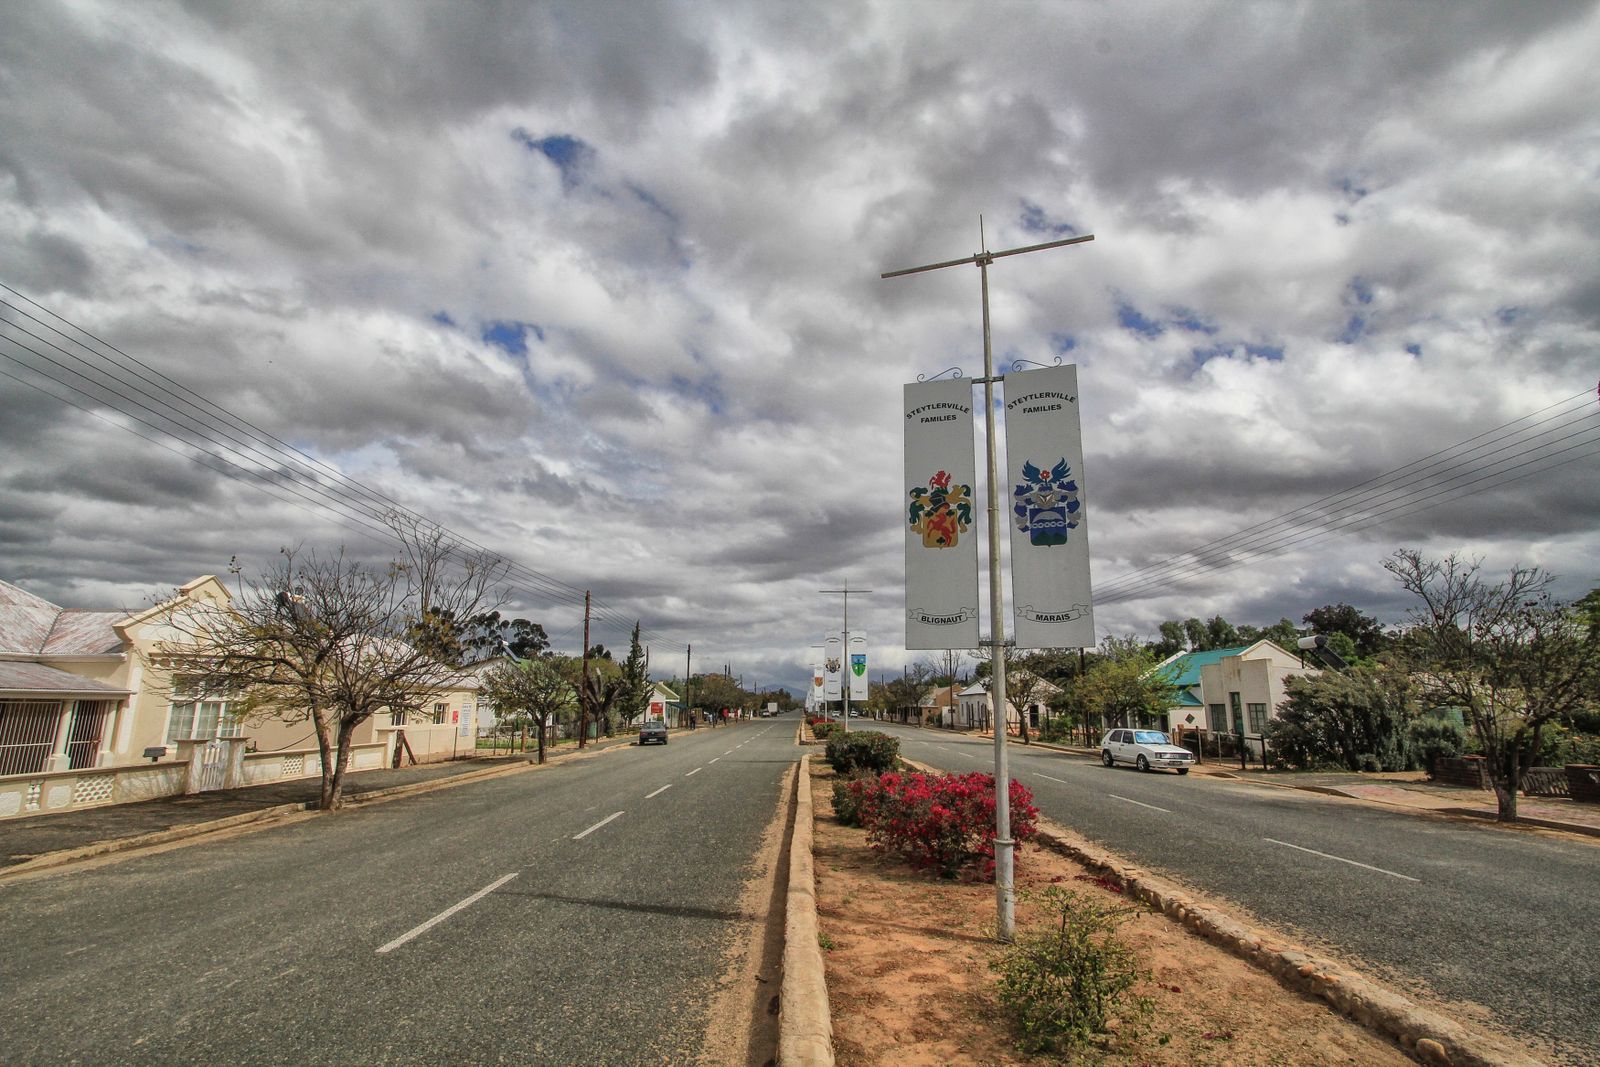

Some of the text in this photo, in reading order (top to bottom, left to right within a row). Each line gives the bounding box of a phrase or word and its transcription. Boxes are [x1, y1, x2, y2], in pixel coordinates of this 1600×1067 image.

[1007, 391, 1076, 410] STEYTLERVILLE
[906, 402, 970, 420] STEYTLERVILLE
[1022, 403, 1062, 414] FAMILIES
[920, 414, 957, 424] FAMILIES
[921, 614, 964, 624] BLIGNAUT
[1035, 613, 1071, 622] MARAIS
